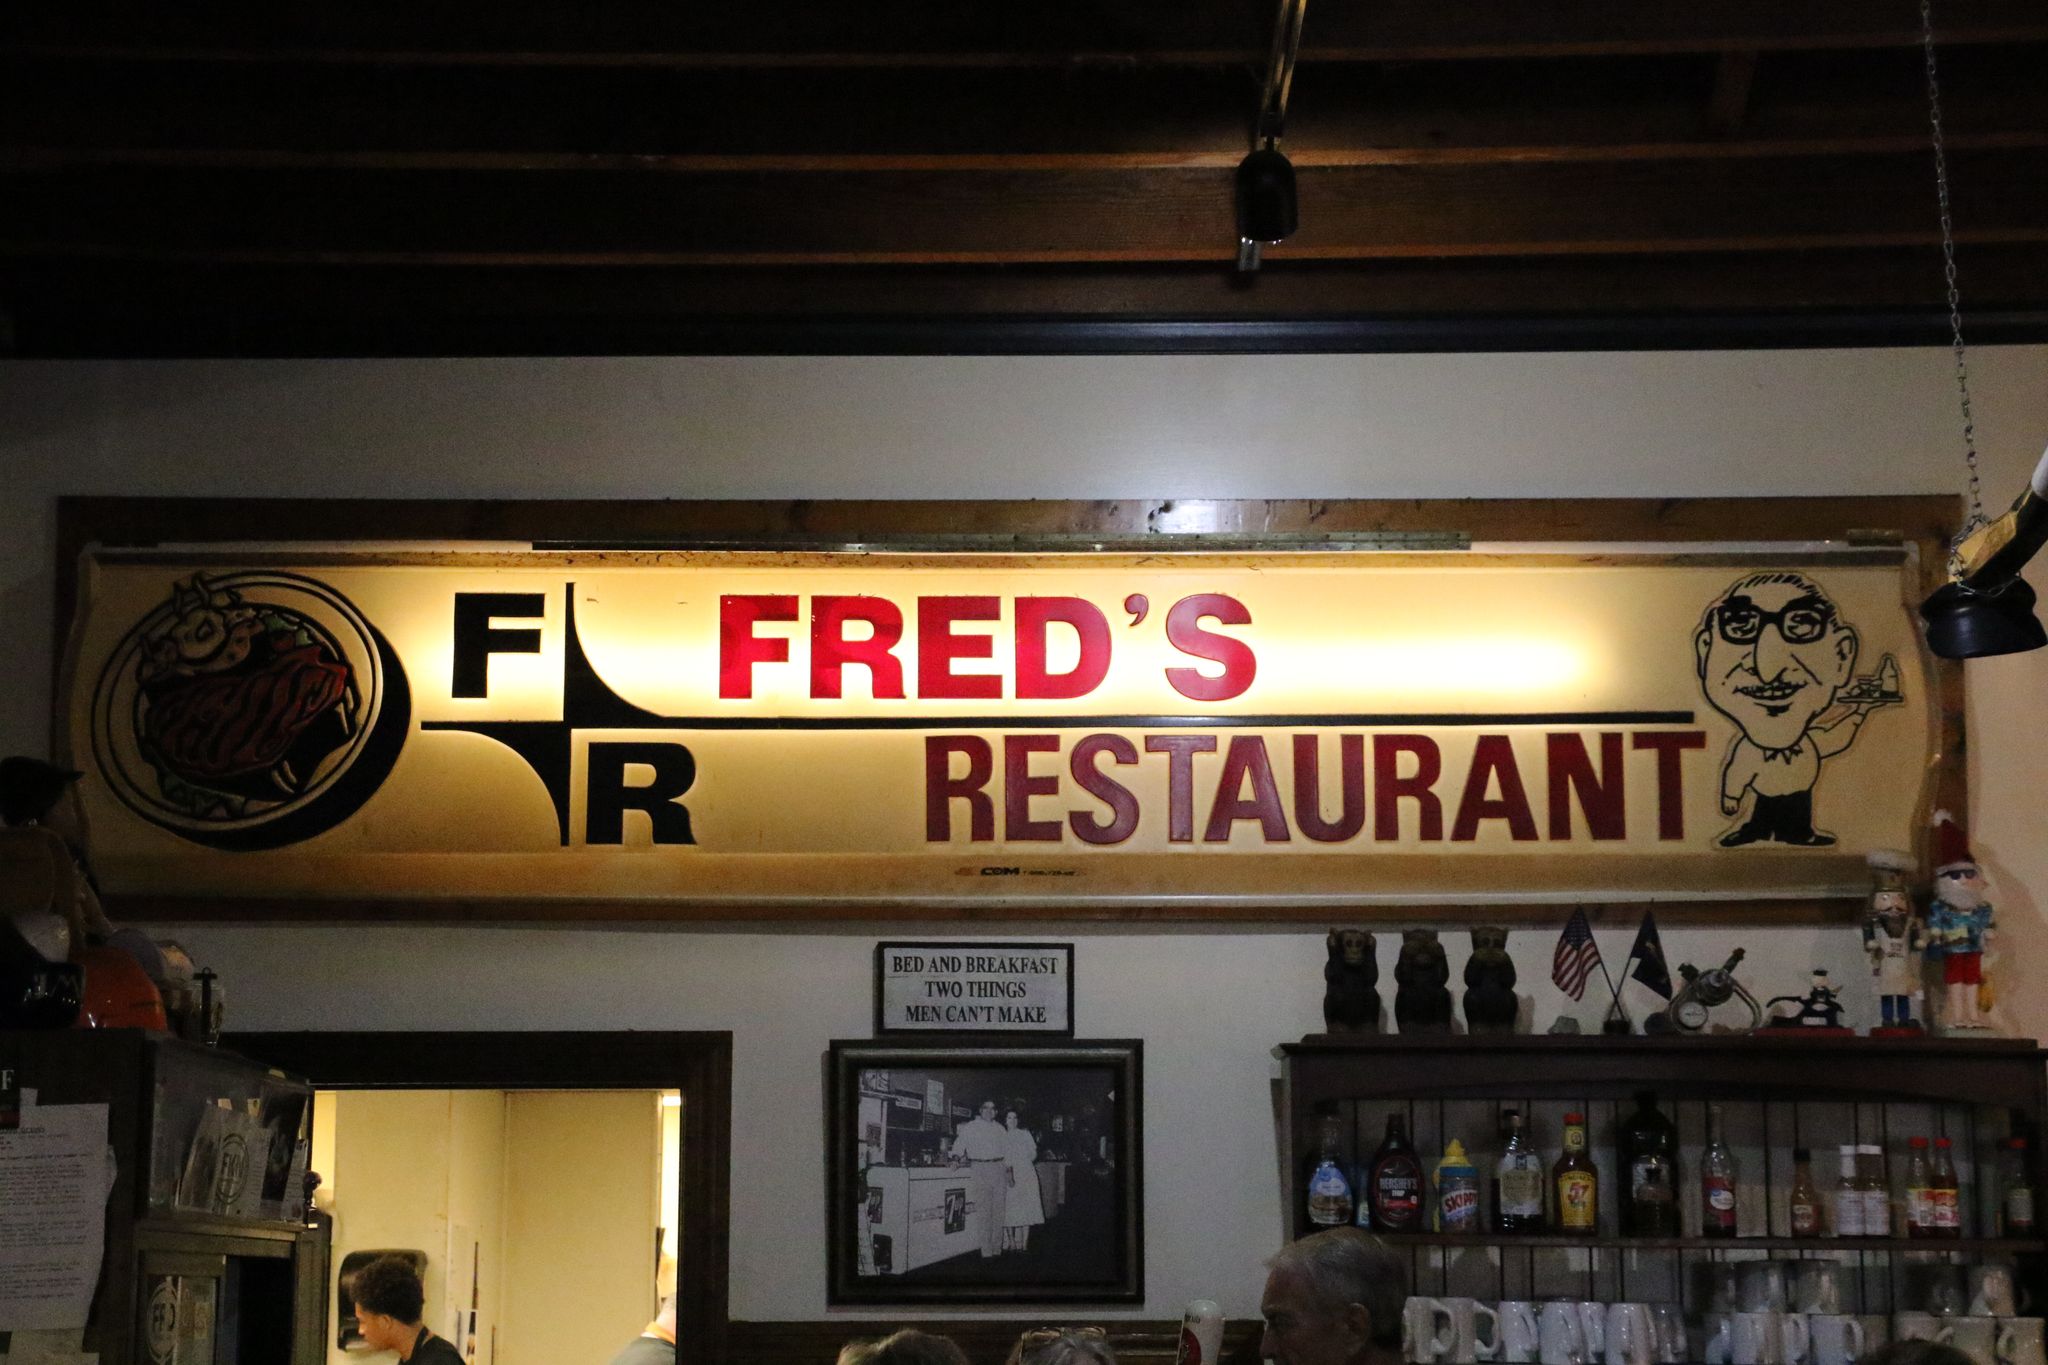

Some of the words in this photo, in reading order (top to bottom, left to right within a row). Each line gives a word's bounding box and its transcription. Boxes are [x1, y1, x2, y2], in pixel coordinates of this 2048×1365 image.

[452, 593, 545, 698] F
[719, 592, 1257, 702] FRED'S
[586, 742, 698, 845] R
[925, 731, 1707, 846] RESTAURANT
[893, 956, 925, 973] BED
[928, 956, 961, 973] AND
[966, 957, 1059, 974] BREAKFAST
[906, 1005, 941, 1022] MEN
[946, 1006, 994, 1023] CAN'T
[999, 1006, 1047, 1024] MAKE
[925, 981, 963, 998] TWO
[966, 981, 1027, 998] THINGS
